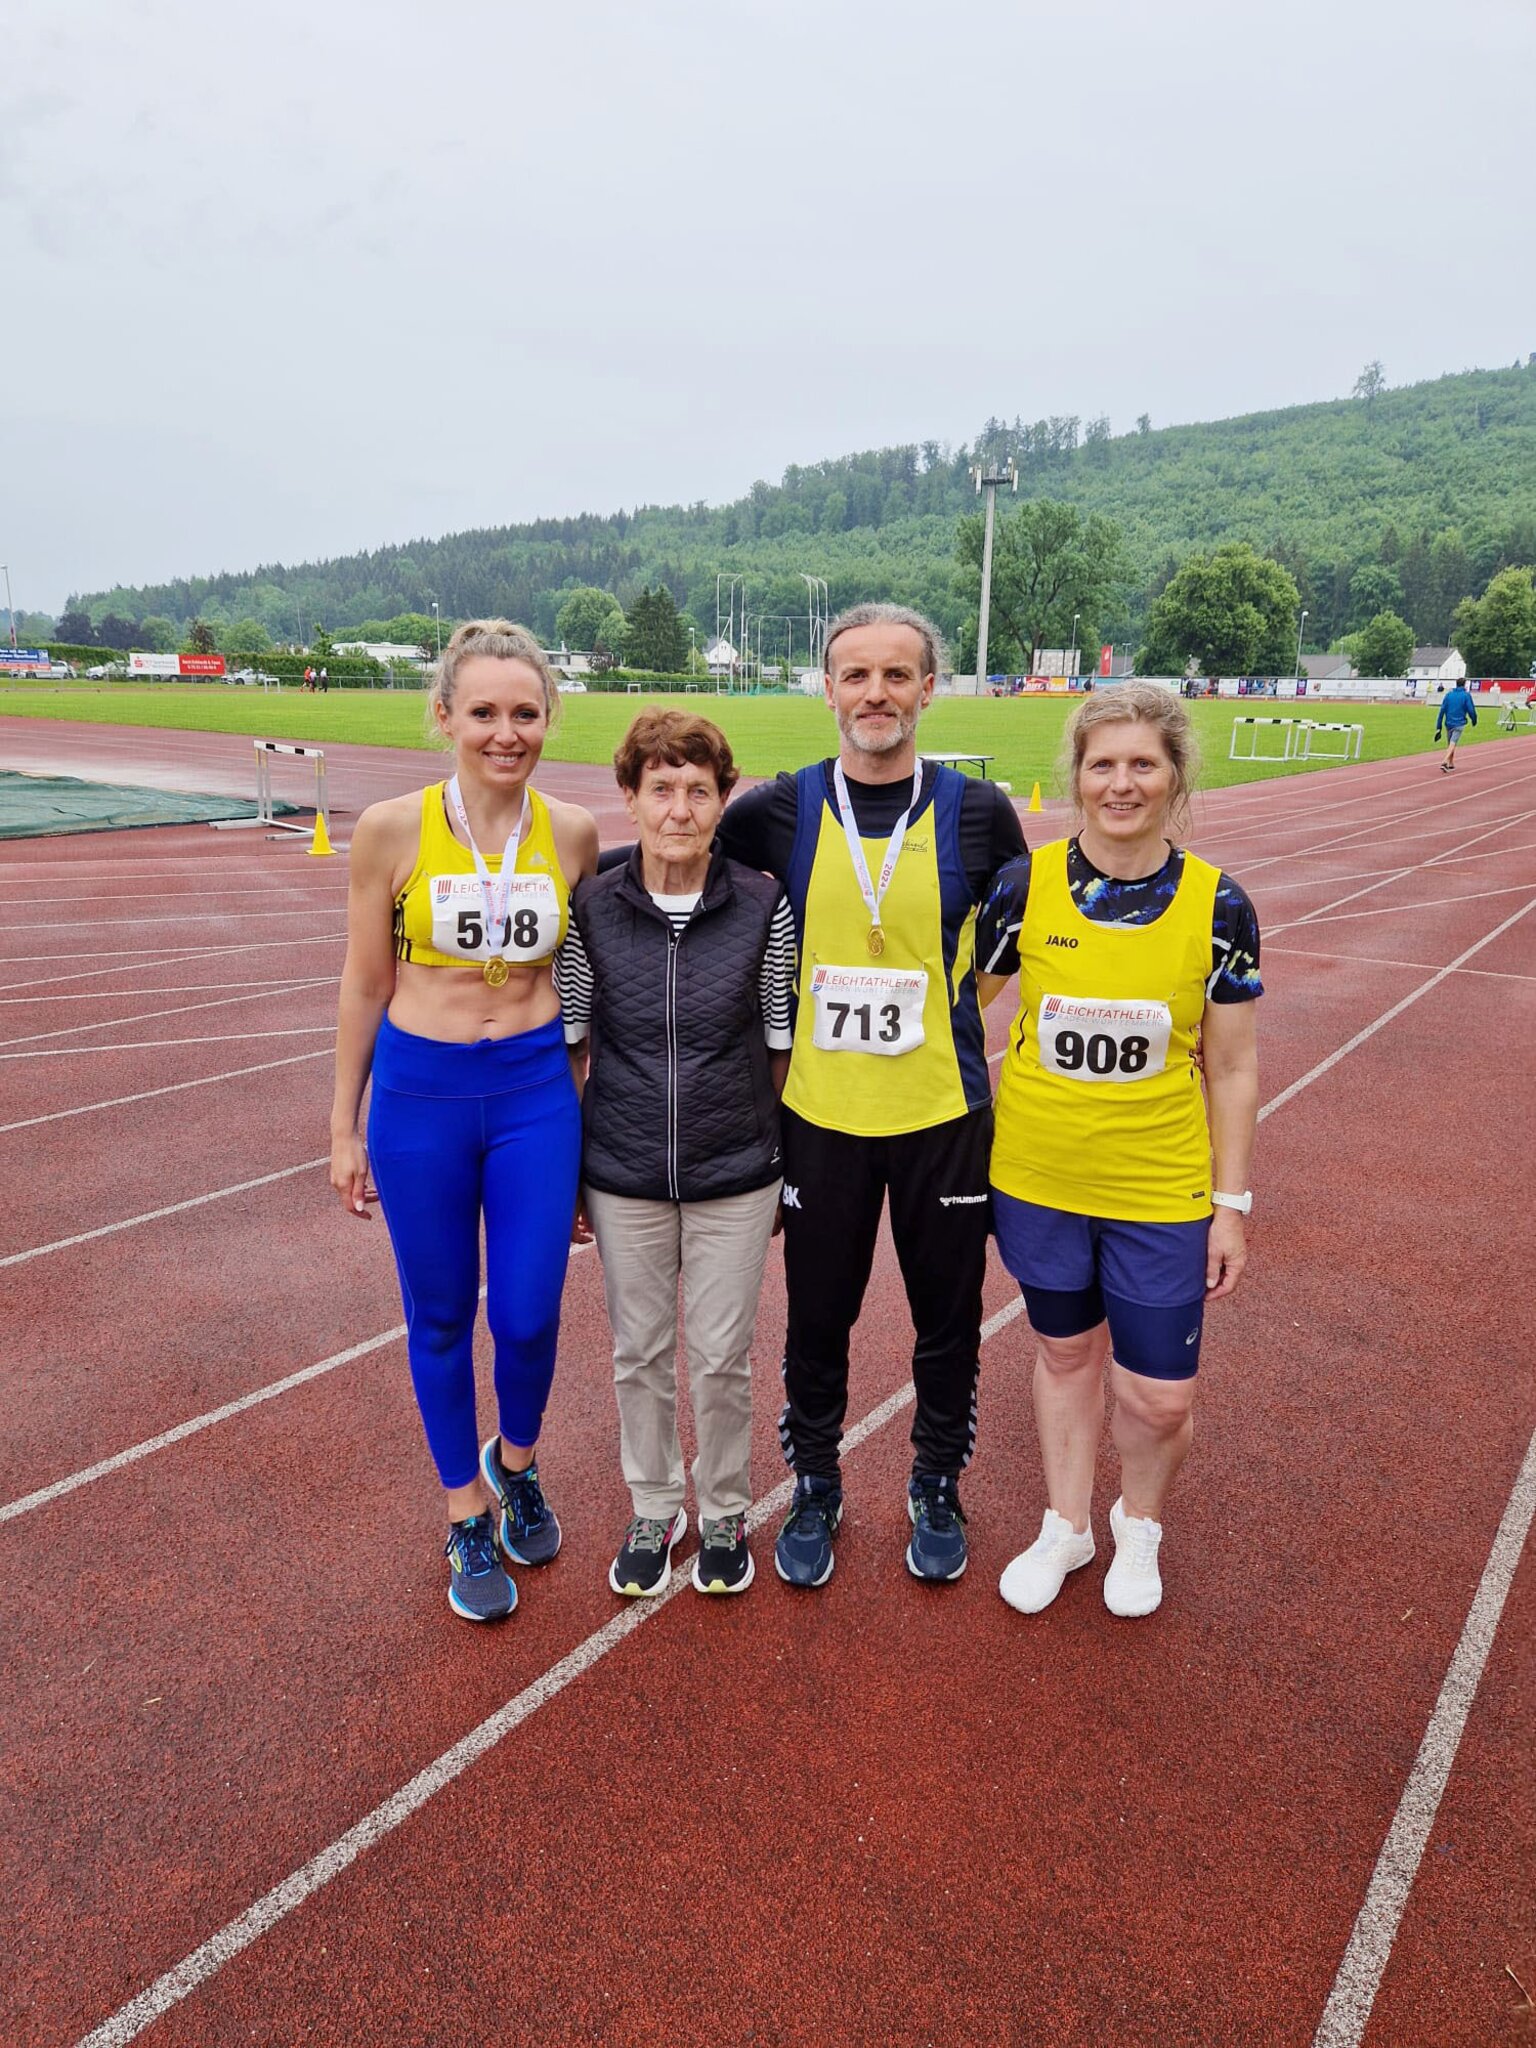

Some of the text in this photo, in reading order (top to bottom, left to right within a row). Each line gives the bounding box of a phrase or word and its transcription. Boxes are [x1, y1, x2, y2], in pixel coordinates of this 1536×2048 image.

[880, 863, 893, 888] 2024
[453, 880, 549, 894] LEICHLETIK
[1045, 934, 1079, 949] JAKO
[826, 975, 921, 989] LEICHTATHLETIK
[1060, 1004, 1164, 1020] LEICHTATHLETIK
[827, 1002, 901, 1043] 713
[1055, 1030, 1150, 1075] 908
